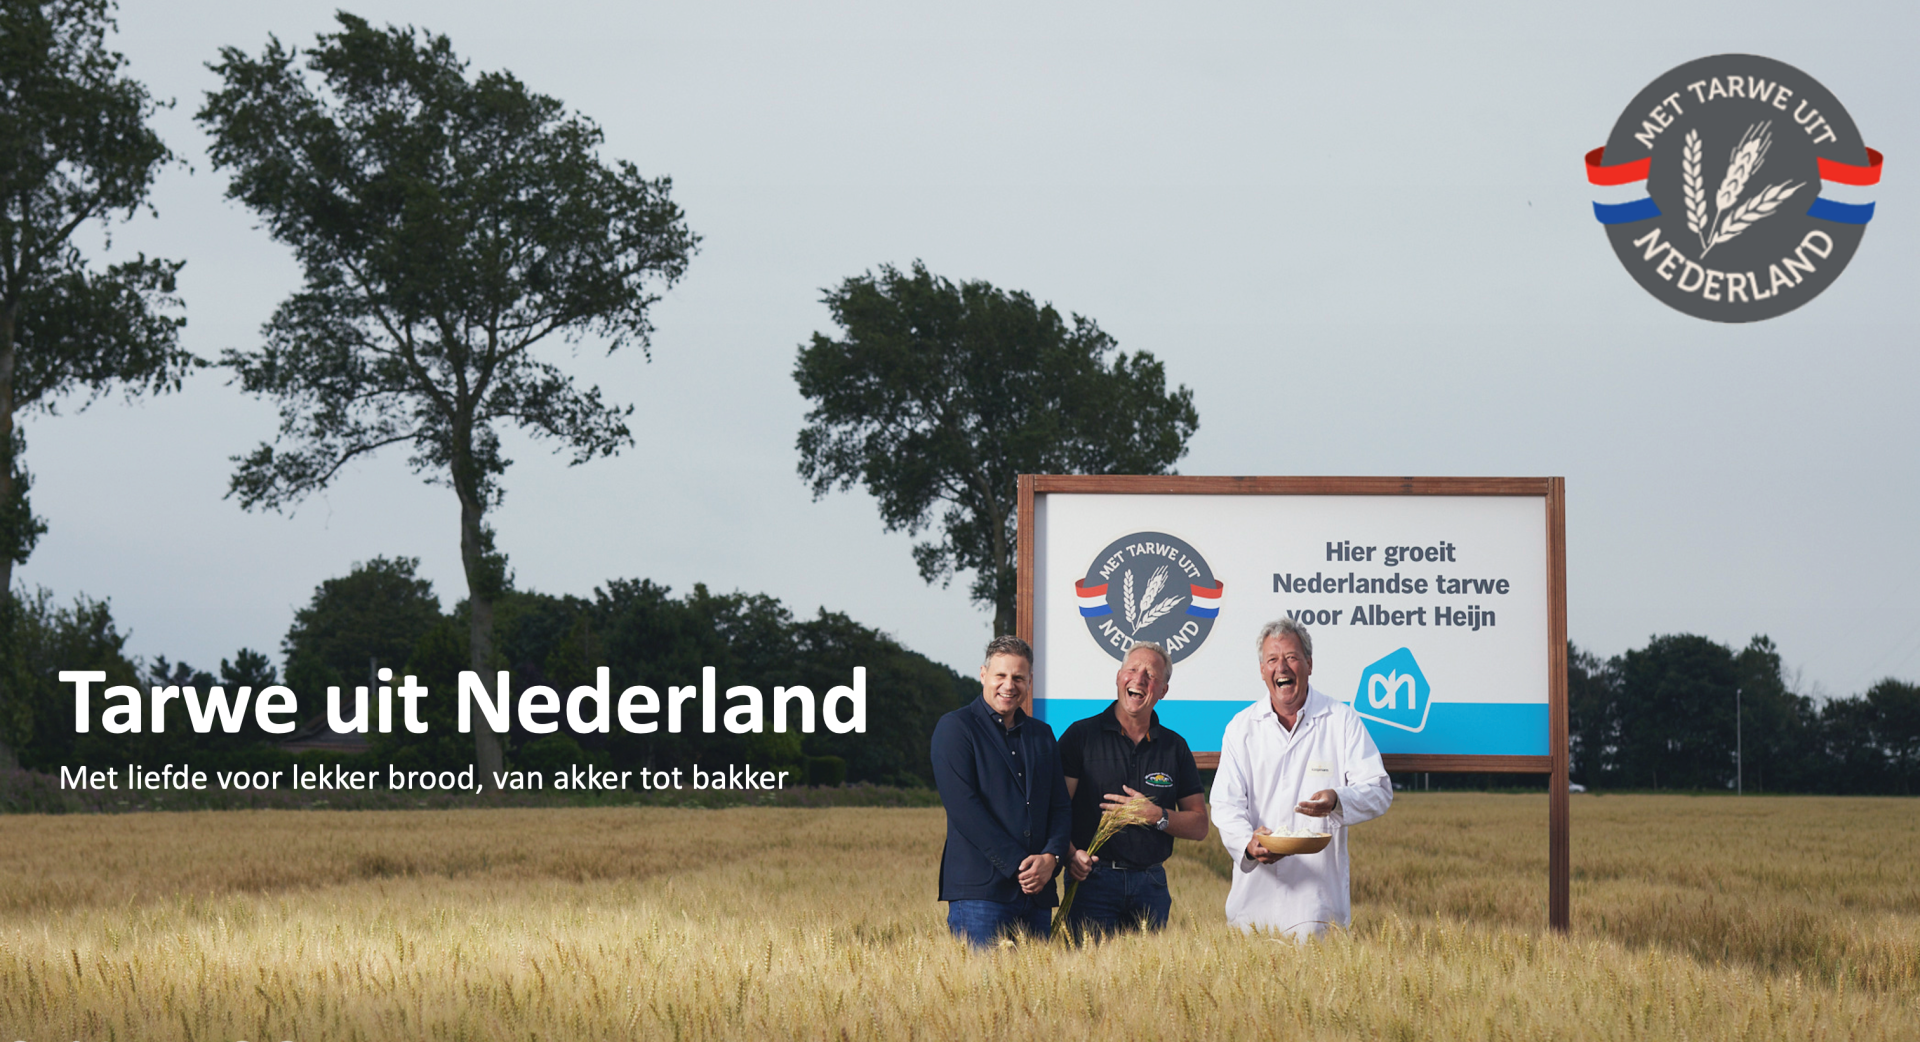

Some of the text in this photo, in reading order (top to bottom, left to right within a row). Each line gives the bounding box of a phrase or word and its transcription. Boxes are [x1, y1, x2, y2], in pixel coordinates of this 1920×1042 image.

[1099, 542, 1201, 580] MET TARWE UIT
[1325, 540, 1456, 567] Hier groeit
[1272, 571, 1510, 595] Nederlandse tarwe
[1286, 604, 1496, 632] voor Albert Heijn
[1098, 618, 1200, 656] NEDAND
